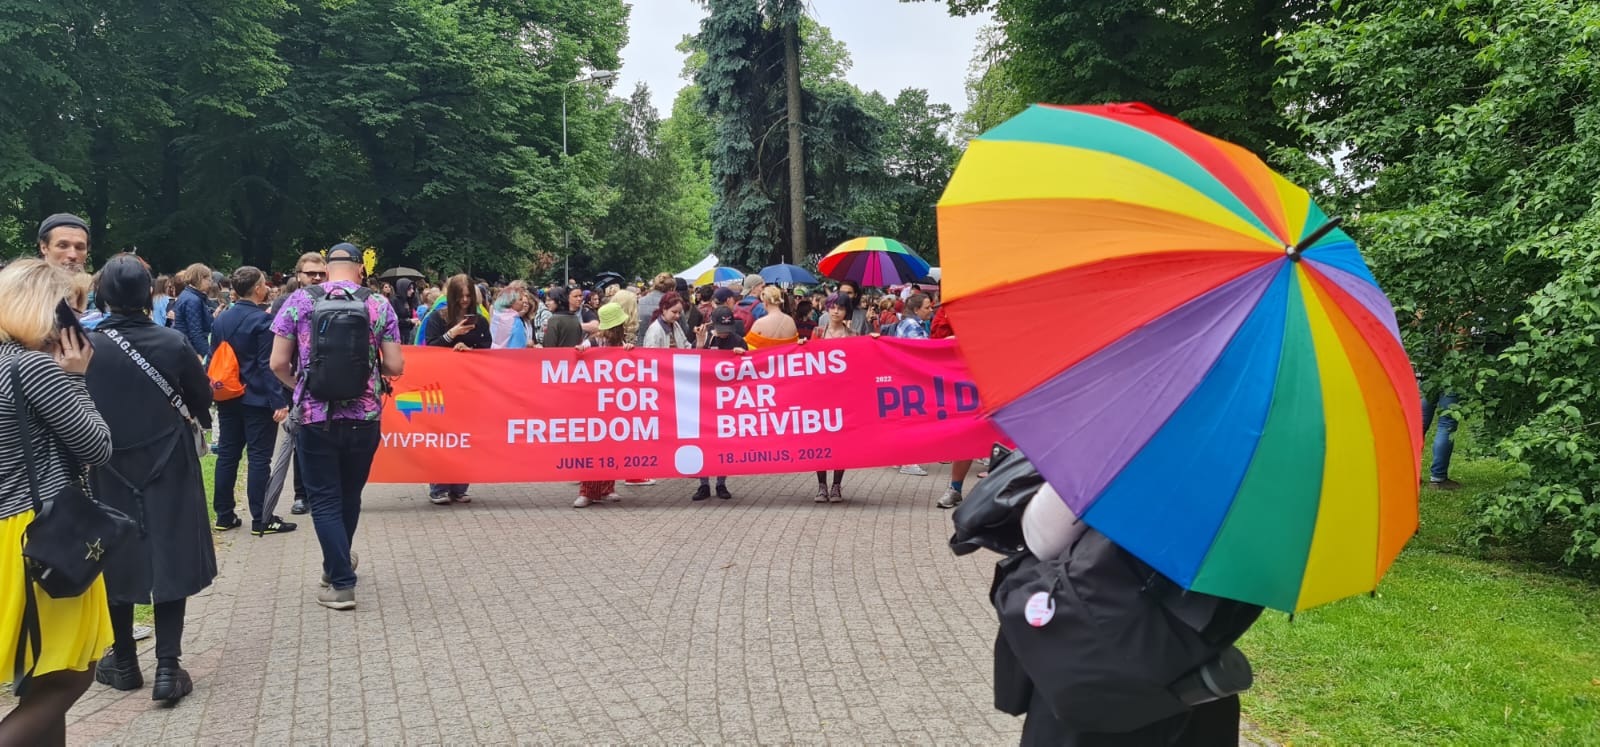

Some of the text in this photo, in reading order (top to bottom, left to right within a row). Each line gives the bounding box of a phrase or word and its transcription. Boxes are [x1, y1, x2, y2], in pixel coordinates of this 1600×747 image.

[541, 358, 658, 384] MARCH
[715, 349, 847, 381] GĀJIENS
[875, 375, 892, 383] 2022
[598, 387, 659, 412] FOR
[716, 384, 776, 409] PAR
[877, 376, 979, 420] PR!D
[507, 416, 659, 444] FREEDOM
[717, 406, 843, 438] BRĪVĪBU
[380, 432, 471, 448] YIVPRIDE
[556, 455, 658, 471] JUNE 18, 2022
[799, 447, 832, 460] 2022
